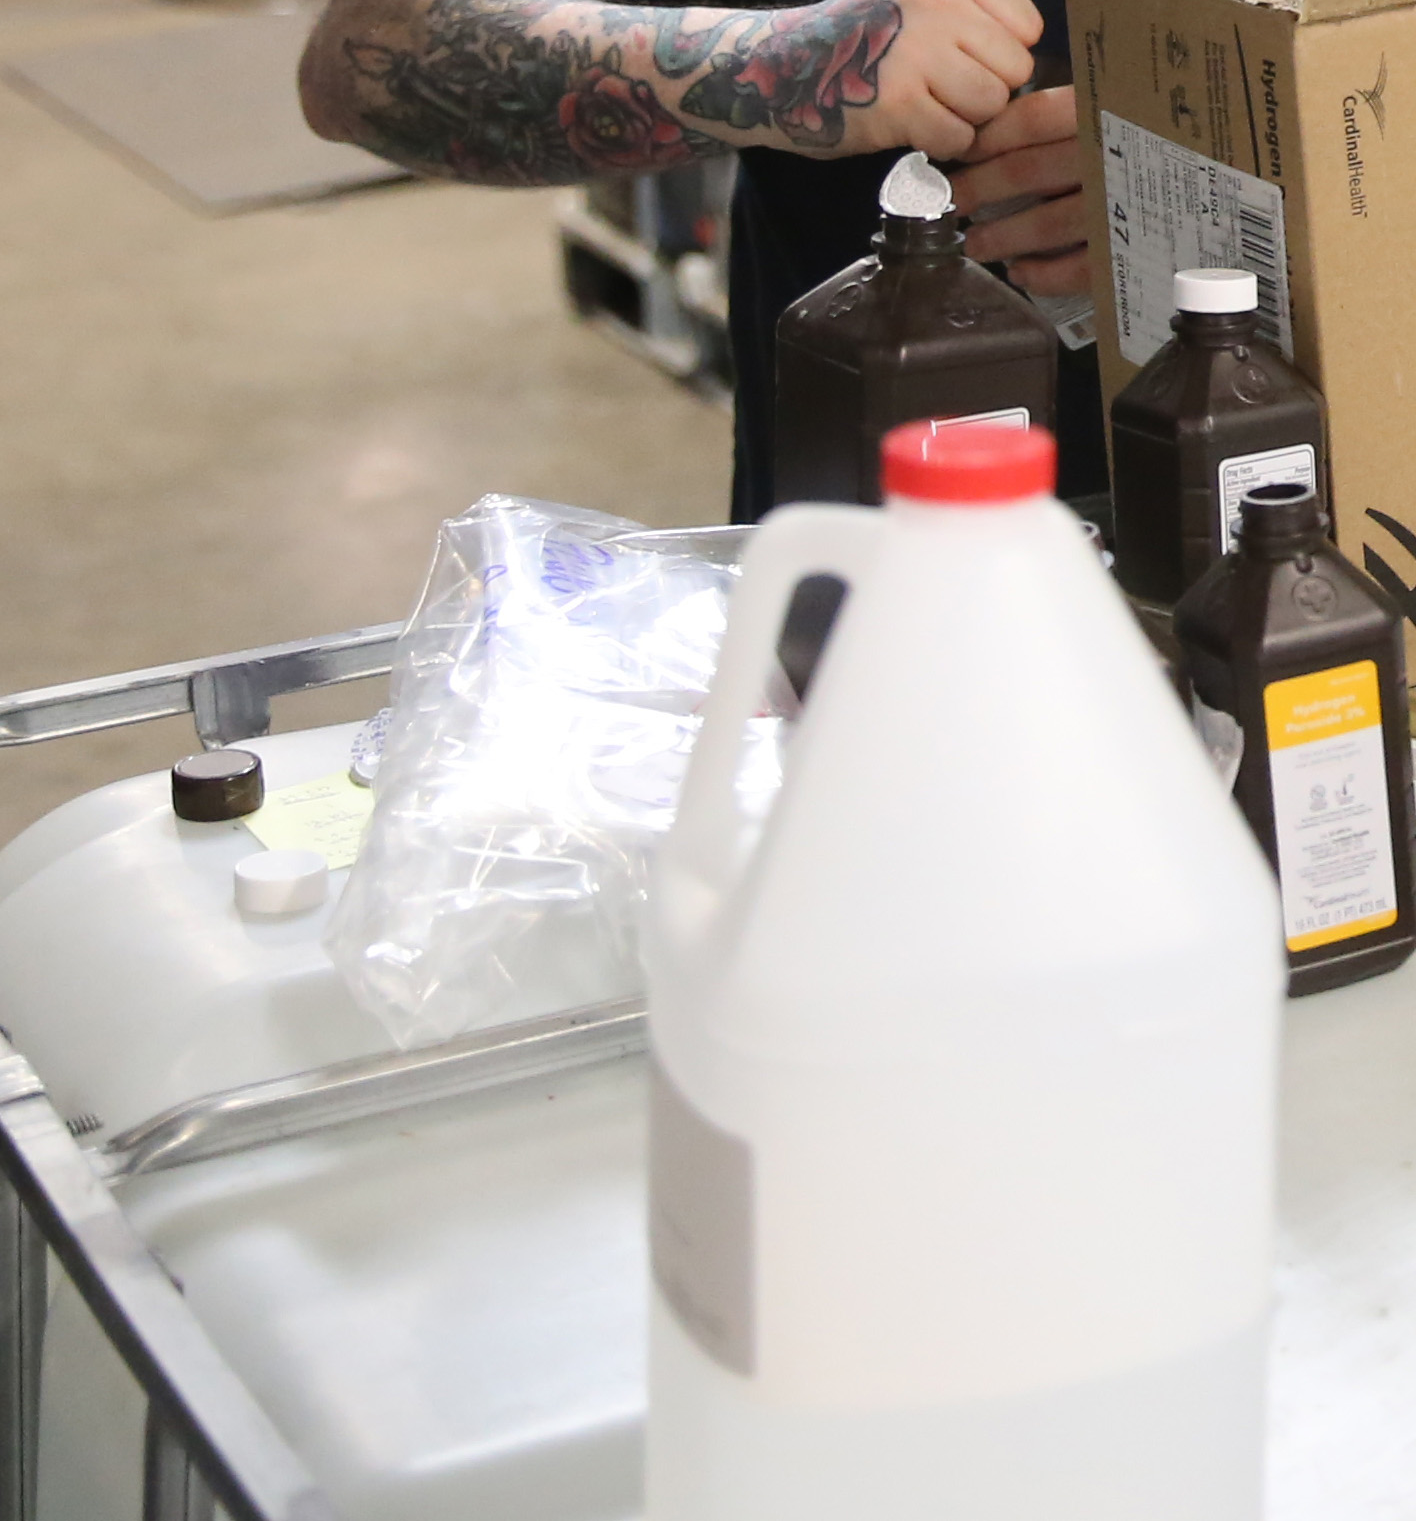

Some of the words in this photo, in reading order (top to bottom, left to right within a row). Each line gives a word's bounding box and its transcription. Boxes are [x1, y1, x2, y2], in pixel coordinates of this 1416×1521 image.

[1261, 59, 1281, 177] Hydrogen
[1342, 95, 1367, 216] CardinalHealth
[1116, 252, 1131, 337] STOREROOM
[1293, 694, 1357, 717] Hydrogen
